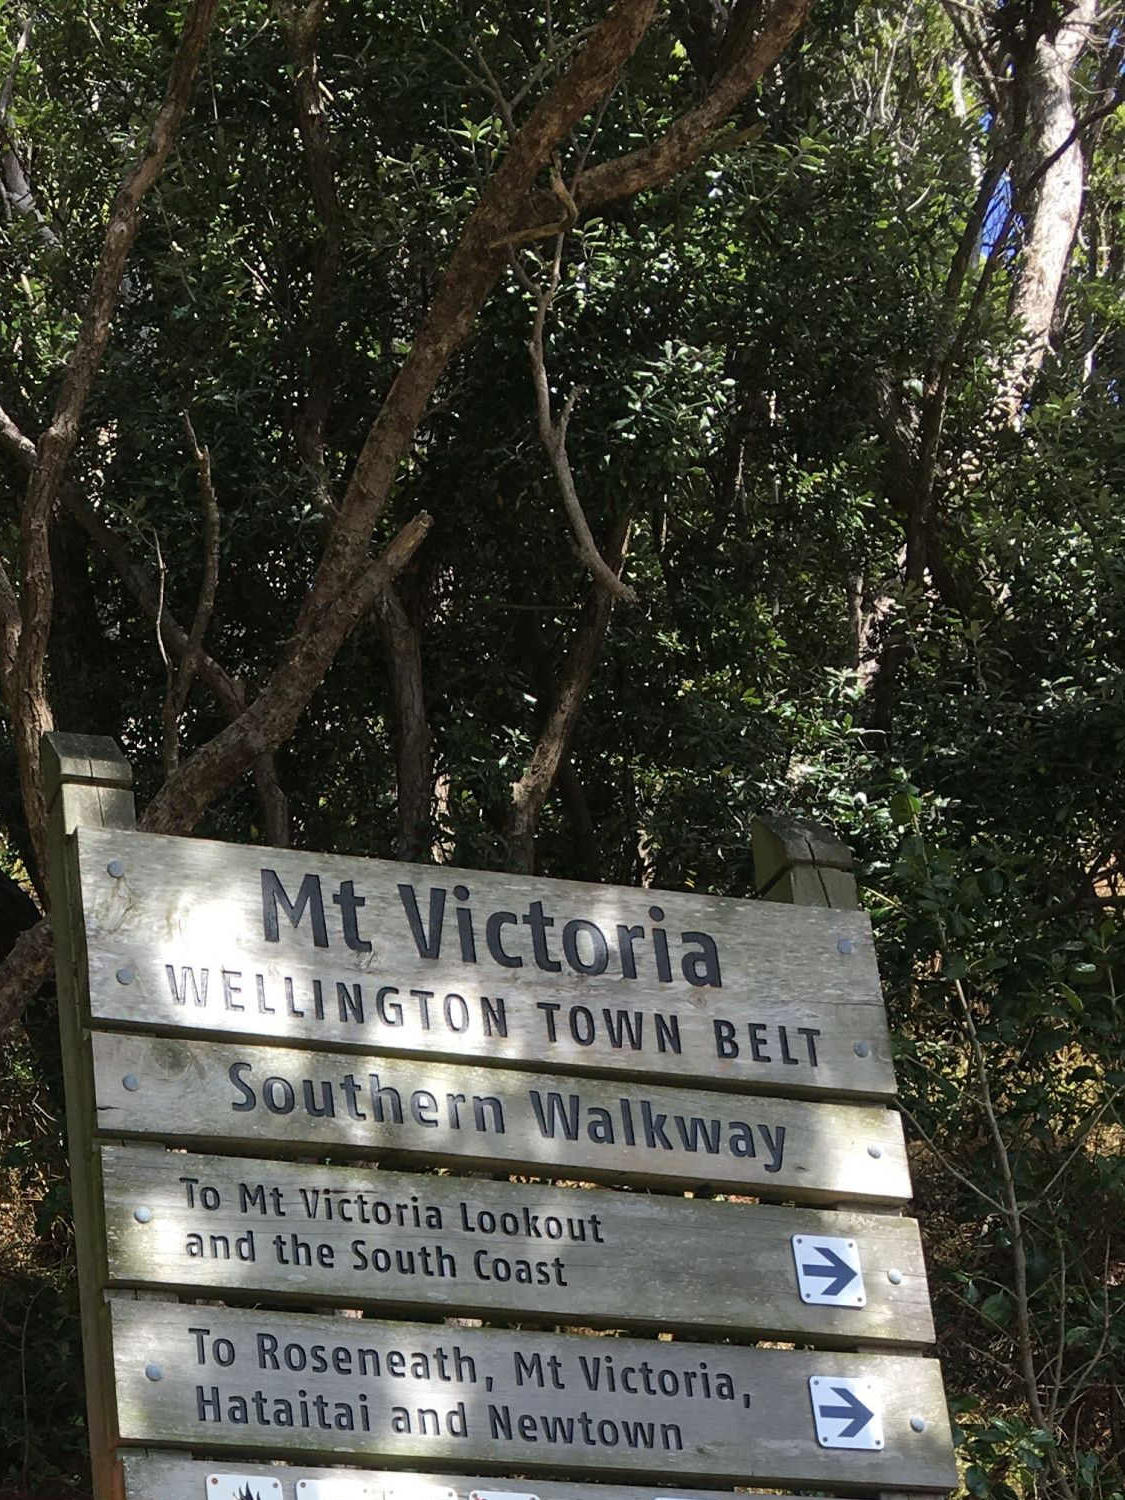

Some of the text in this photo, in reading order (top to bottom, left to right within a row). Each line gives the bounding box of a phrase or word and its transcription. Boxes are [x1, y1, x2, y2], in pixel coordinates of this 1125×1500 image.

[261, 868, 722, 988] Mt Victoria
[165, 964, 821, 1067] WELLINGTON TOWN BELT
[228, 1061, 787, 1173] Southern Walkway
[179, 1177, 605, 1243] To Mt Victoria Lookout
[186, 1230, 568, 1287] and the South Coast
[188, 1328, 751, 1409] To Roseneath, Mt Victoria,
[195, 1385, 683, 1450] Hataitai and Newtown
